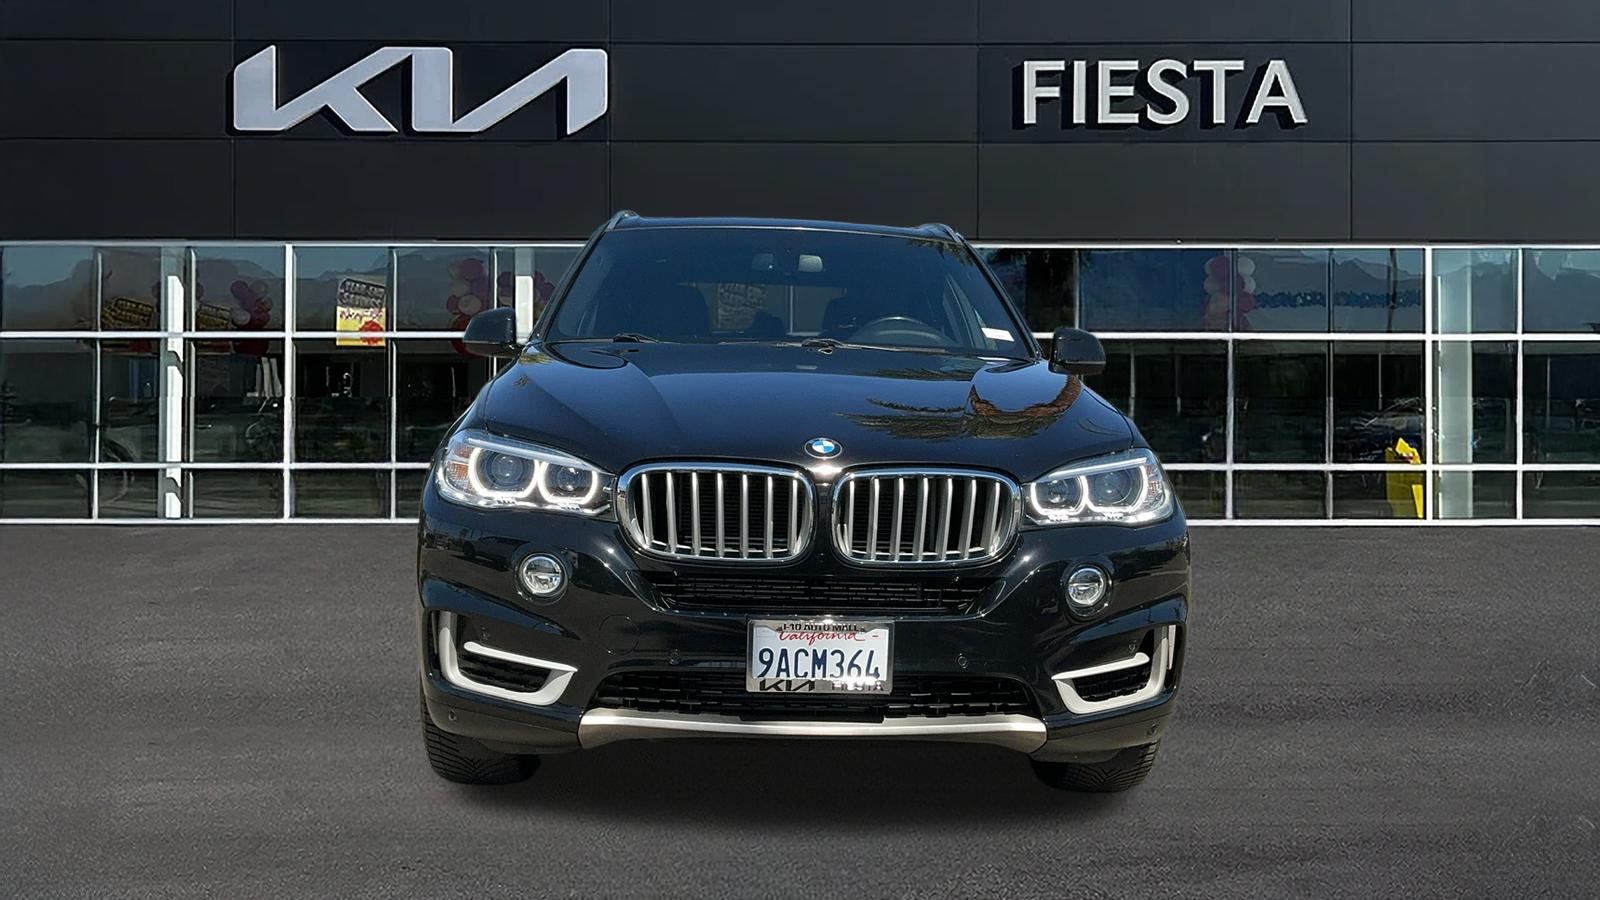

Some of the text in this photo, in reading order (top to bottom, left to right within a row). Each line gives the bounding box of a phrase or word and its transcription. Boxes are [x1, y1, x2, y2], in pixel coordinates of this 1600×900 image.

[233, 45, 608, 135] KIA
[1023, 59, 1308, 125] FIESTA
[783, 623, 859, 632] I-10 AUTO MALL
[757, 647, 880, 679] 9ACM364
[759, 679, 815, 691] KIA
